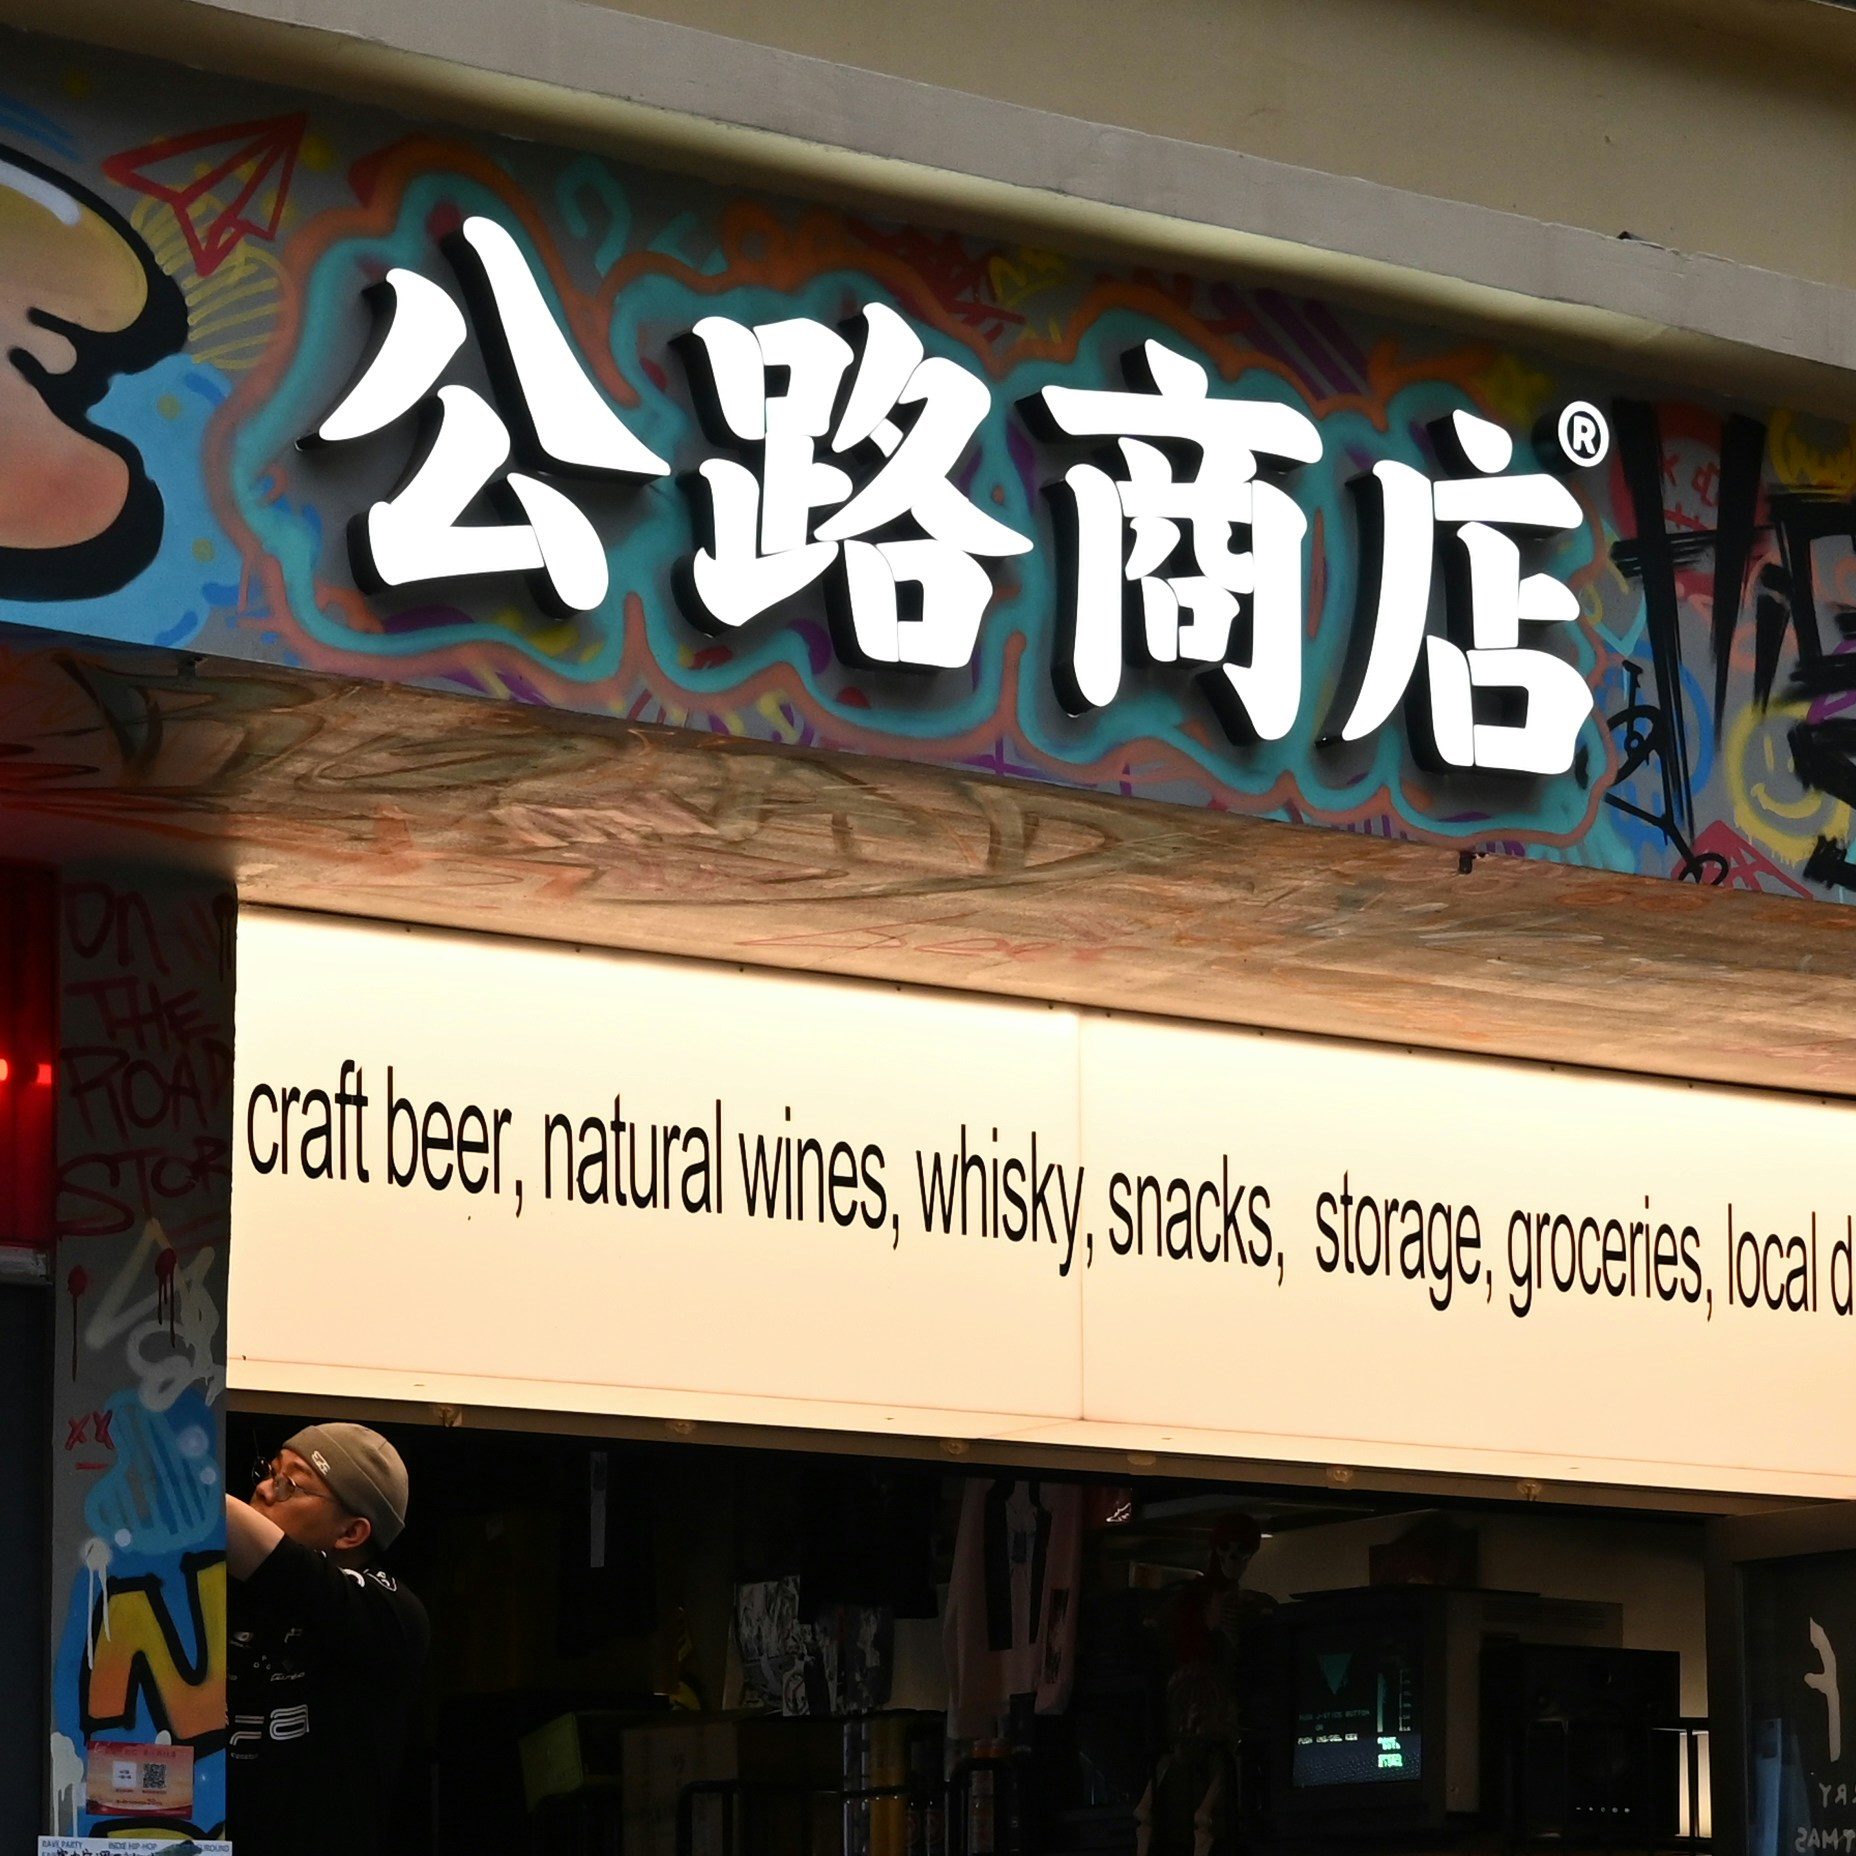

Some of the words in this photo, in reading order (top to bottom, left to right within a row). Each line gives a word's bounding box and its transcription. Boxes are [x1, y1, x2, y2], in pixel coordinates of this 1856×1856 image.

[304, 217, 1594, 776] 公路商店
[248, 1060, 369, 1184] craft
[388, 1066, 523, 1218] beer,
[545, 1095, 723, 1214] natural
[739, 1105, 899, 1250] wines,
[916, 1124, 1093, 1277] whisky,
[1109, 1150, 1284, 1287] snacks,
[1316, 1171, 1492, 1312] storage,
[1508, 1196, 1712, 1322] groceries,
[1728, 1204, 1817, 1312] local
